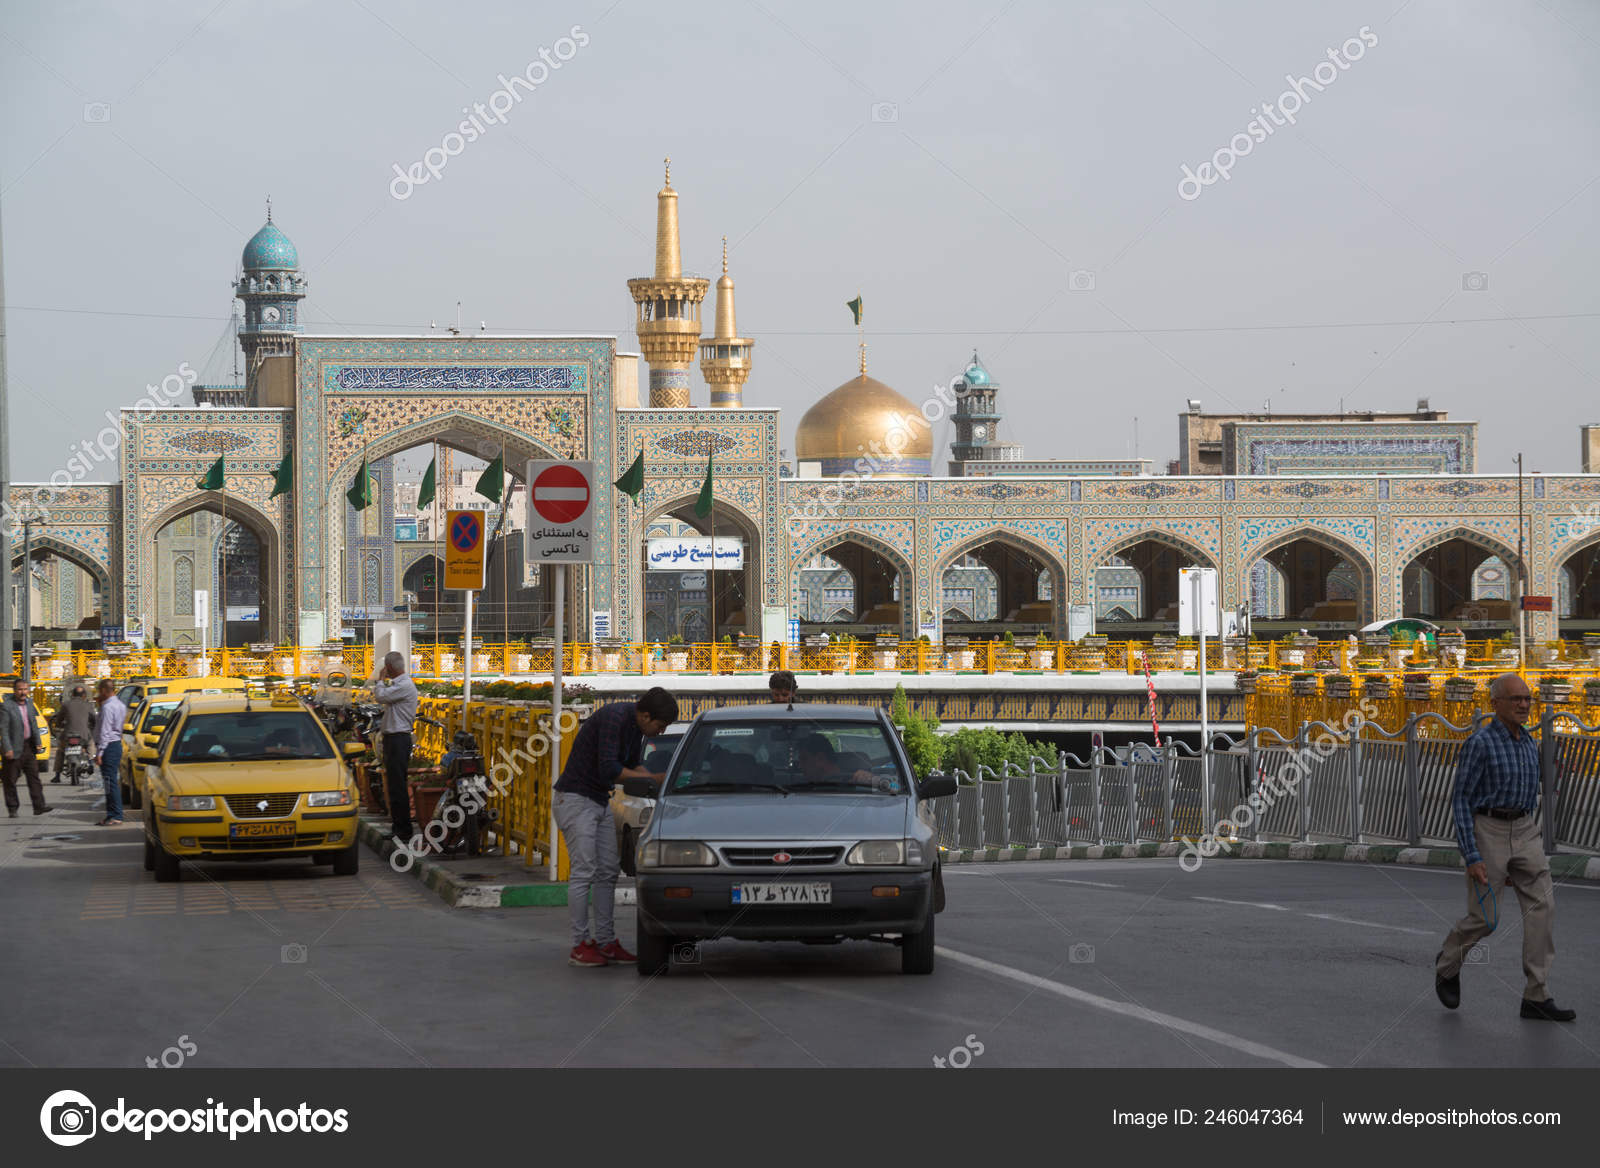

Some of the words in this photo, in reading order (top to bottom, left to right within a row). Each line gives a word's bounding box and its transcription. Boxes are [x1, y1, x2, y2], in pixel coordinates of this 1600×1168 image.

[532, 528, 575, 540] استثنای
[576, 529, 589, 541] به
[542, 544, 580, 557] تاکسی
[651, 544, 688, 562] طوسی
[690, 545, 714, 562] شیخ
[715, 547, 741, 562] بست
[744, 886, 760, 901] ۱۳
[765, 886, 776, 901] ط
[781, 886, 808, 901] ۲۷۸
